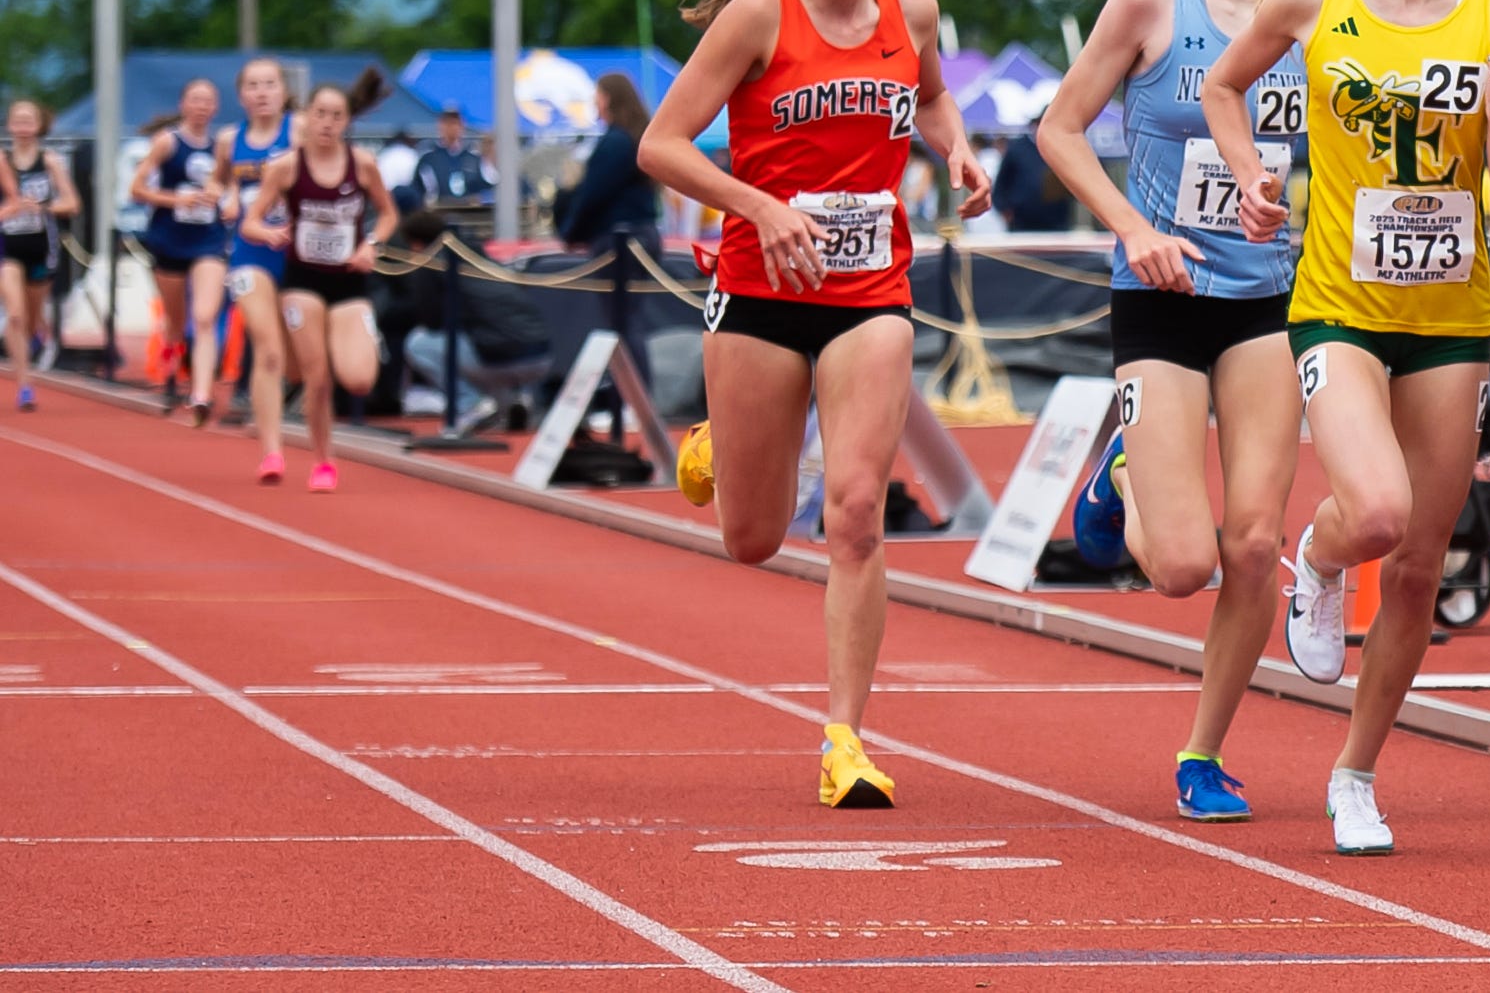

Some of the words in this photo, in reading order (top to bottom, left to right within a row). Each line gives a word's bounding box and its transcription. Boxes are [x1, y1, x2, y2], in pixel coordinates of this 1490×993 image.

[1422, 64, 1480, 111] 25
[1259, 89, 1302, 133] 26
[1369, 214, 1394, 223] 2025
[1397, 216, 1428, 224] TRACK
[1439, 216, 1462, 224] FIELD
[1376, 224, 1454, 232] CHAMPIONSHIPS
[823, 225, 877, 257] 951
[1370, 232, 1462, 270] 1573
[1395, 271, 1447, 282] ATHLETIC
[1118, 383, 1134, 426] 6
